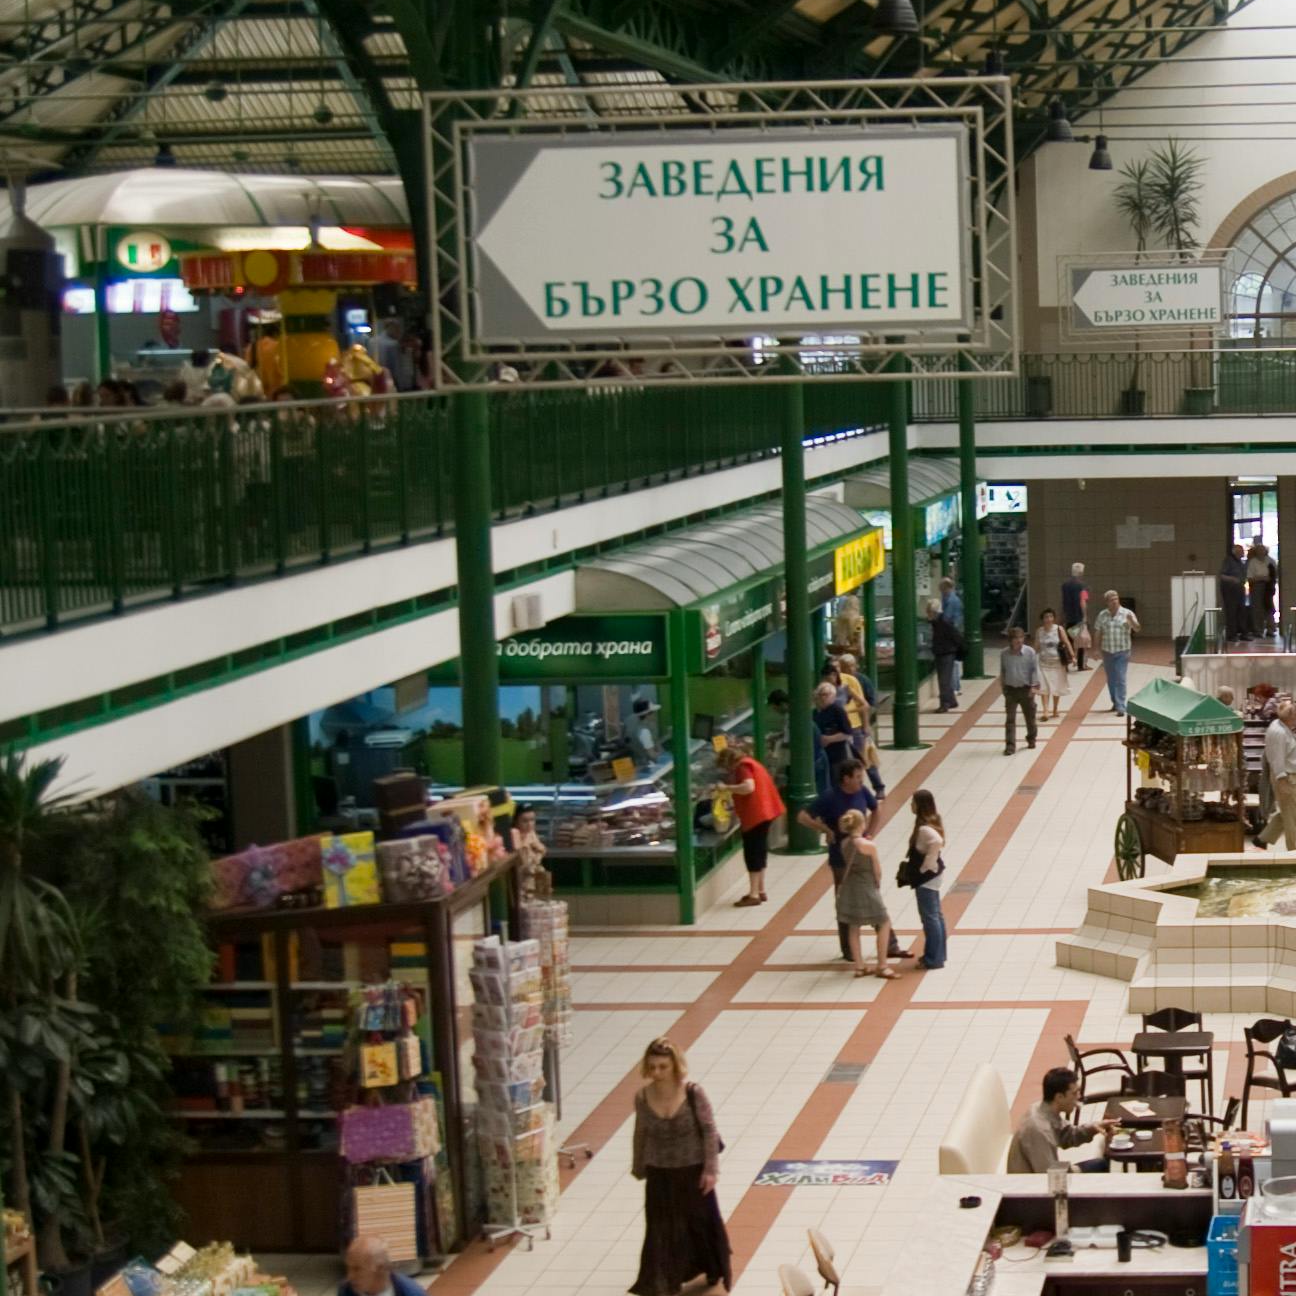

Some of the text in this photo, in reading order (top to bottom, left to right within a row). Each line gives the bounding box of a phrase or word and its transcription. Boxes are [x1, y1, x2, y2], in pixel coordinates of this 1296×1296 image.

[597, 154, 886, 202] ЗАВЕДЕНИЯ
[709, 215, 771, 255] ЗА
[1110, 272, 1198, 287] ЗАВЕДЕНИЯ
[543, 271, 950, 319] БЪРЗО ХРАНЕНЕ
[1143, 290, 1163, 304] ЗА
[1093, 307, 1217, 323] БЪРЗО ХРАНЕНЕ
[506, 638, 593, 660] добрата
[595, 640, 653, 659] храна
